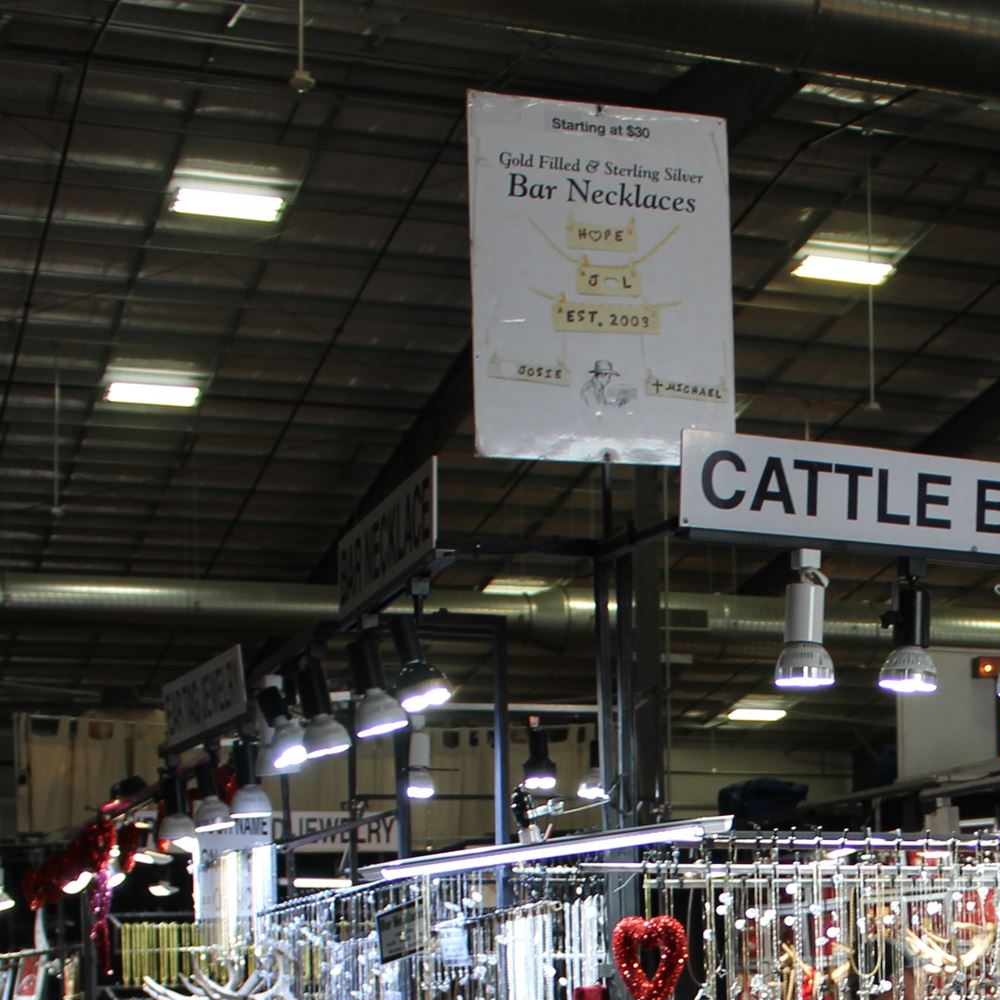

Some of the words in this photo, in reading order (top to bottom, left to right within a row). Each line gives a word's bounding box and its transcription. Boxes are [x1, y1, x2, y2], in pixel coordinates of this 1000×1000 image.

[552, 117, 605, 136] Starting
[609, 122, 624, 135] at
[626, 124, 650, 139] $30
[499, 151, 534, 169] Gold
[538, 154, 580, 173] Filled
[585, 159, 600, 174] &
[604, 162, 660, 184] Sterling
[663, 166, 704, 185] Silver
[508, 173, 557, 201] Bar
[567, 177, 697, 213] Necklaces
[566, 310, 603, 327] EST.
[610, 314, 649, 328] 2003
[518, 364, 563, 380] JOSIE
[665, 381, 722, 399] MICHAEL
[701, 450, 952, 530] CATTLE
